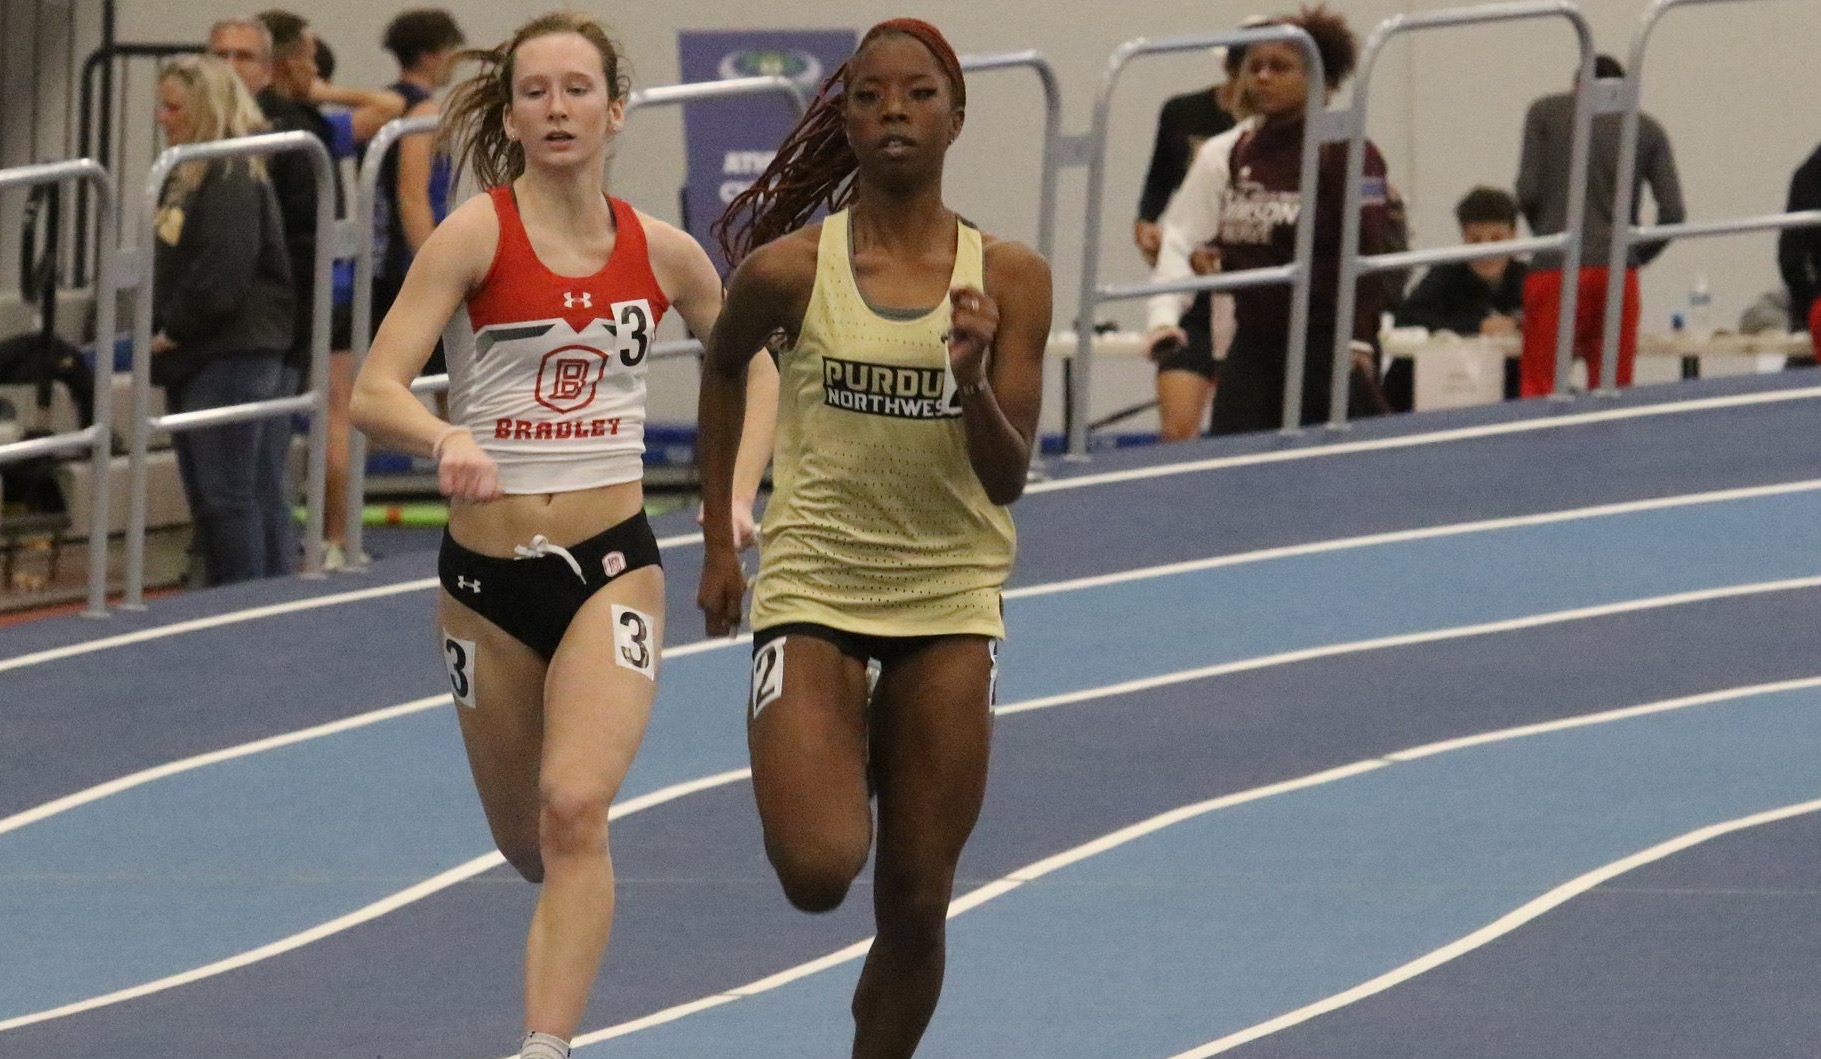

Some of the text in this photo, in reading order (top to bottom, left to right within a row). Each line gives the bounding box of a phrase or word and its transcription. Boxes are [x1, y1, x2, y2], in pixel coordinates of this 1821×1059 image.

[620, 305, 649, 367] 3
[825, 360, 945, 398] PURDU
[828, 388, 945, 417] NORTHWES
[494, 418, 621, 440] BRADLEY
[446, 638, 469, 698] 3
[620, 611, 650, 669] 3
[755, 645, 778, 710] 2
